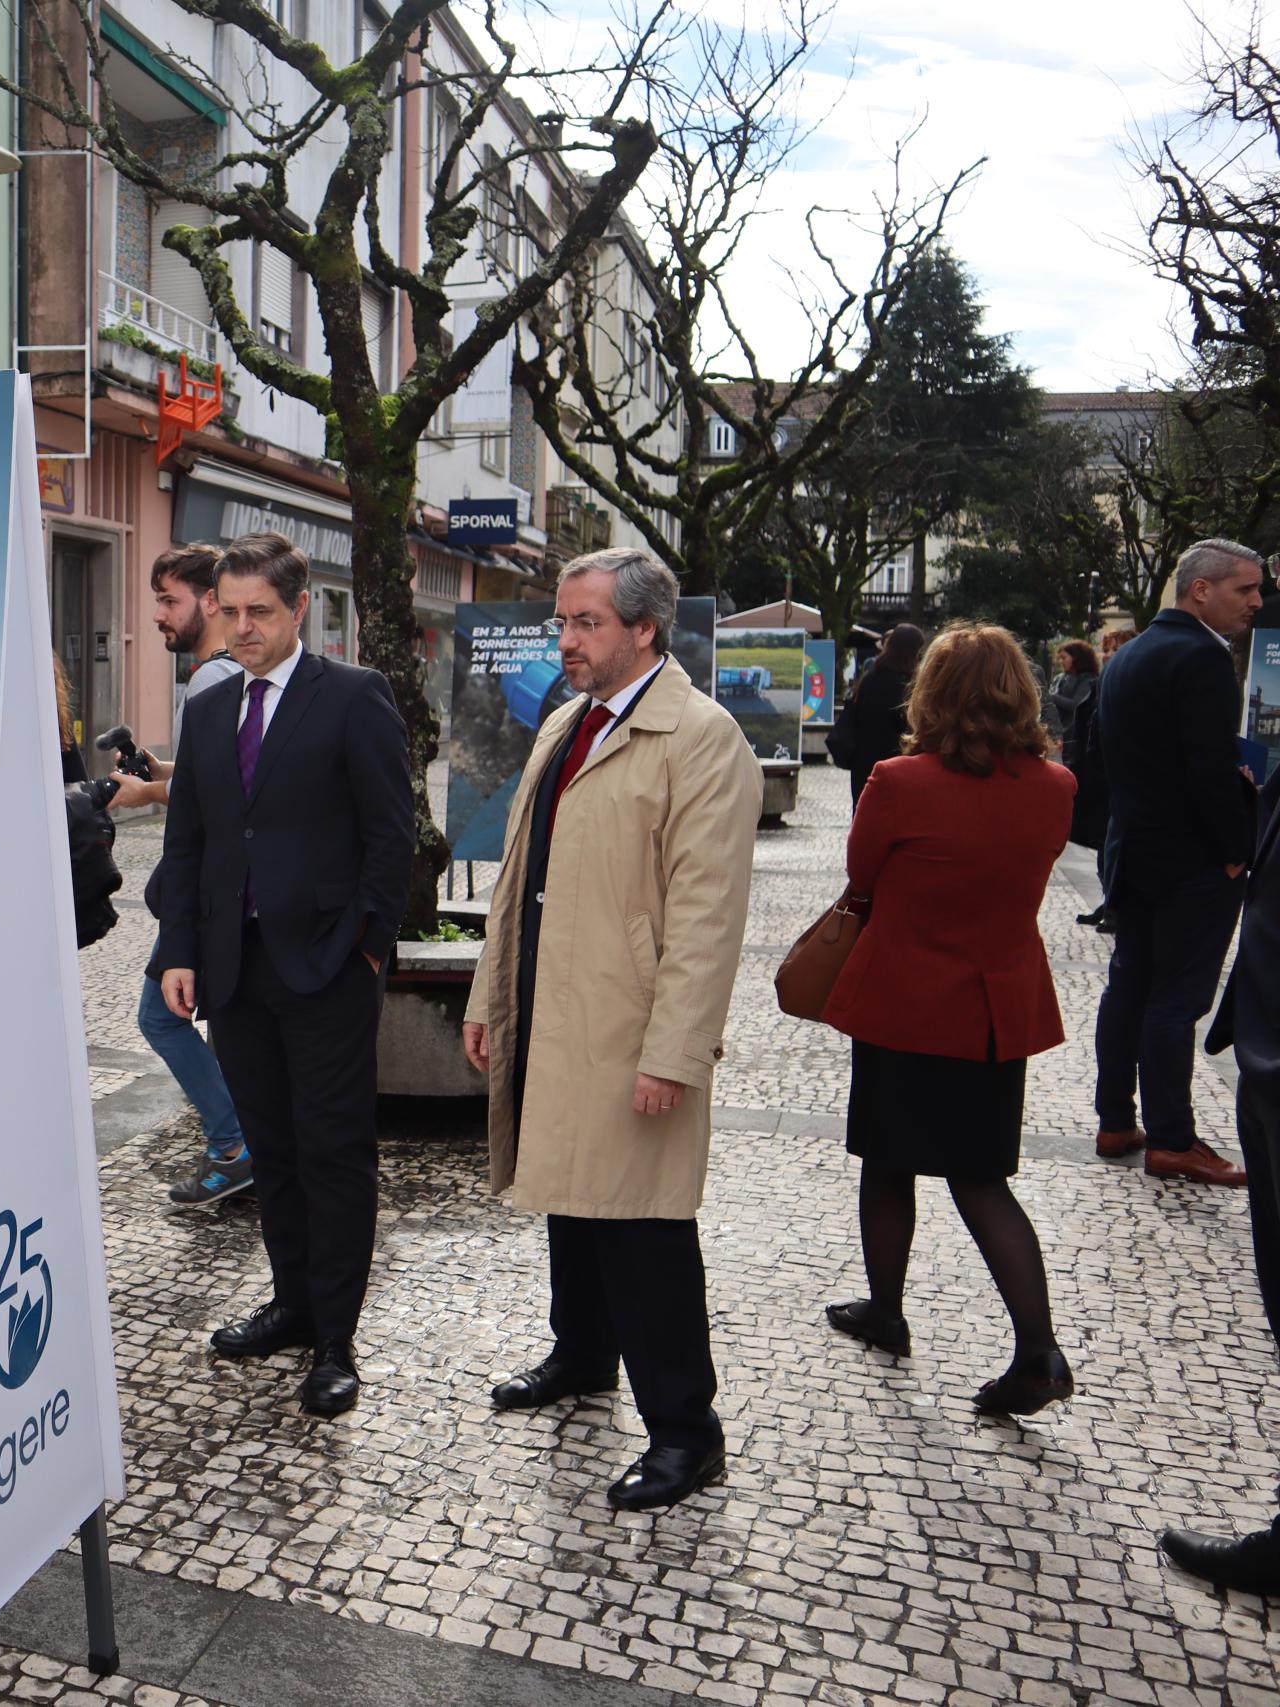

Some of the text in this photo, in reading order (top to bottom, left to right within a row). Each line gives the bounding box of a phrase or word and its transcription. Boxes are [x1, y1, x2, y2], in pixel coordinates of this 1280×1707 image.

[450, 514, 514, 528] SPORVAL
[299, 521, 318, 558] DA
[472, 625, 542, 637] EM 25 ANOS
[472, 638, 548, 649] FORNECEMOS
[471, 649, 562, 662] 241 MILHÕES DE
[471, 660, 522, 673] DE ÁGUA
